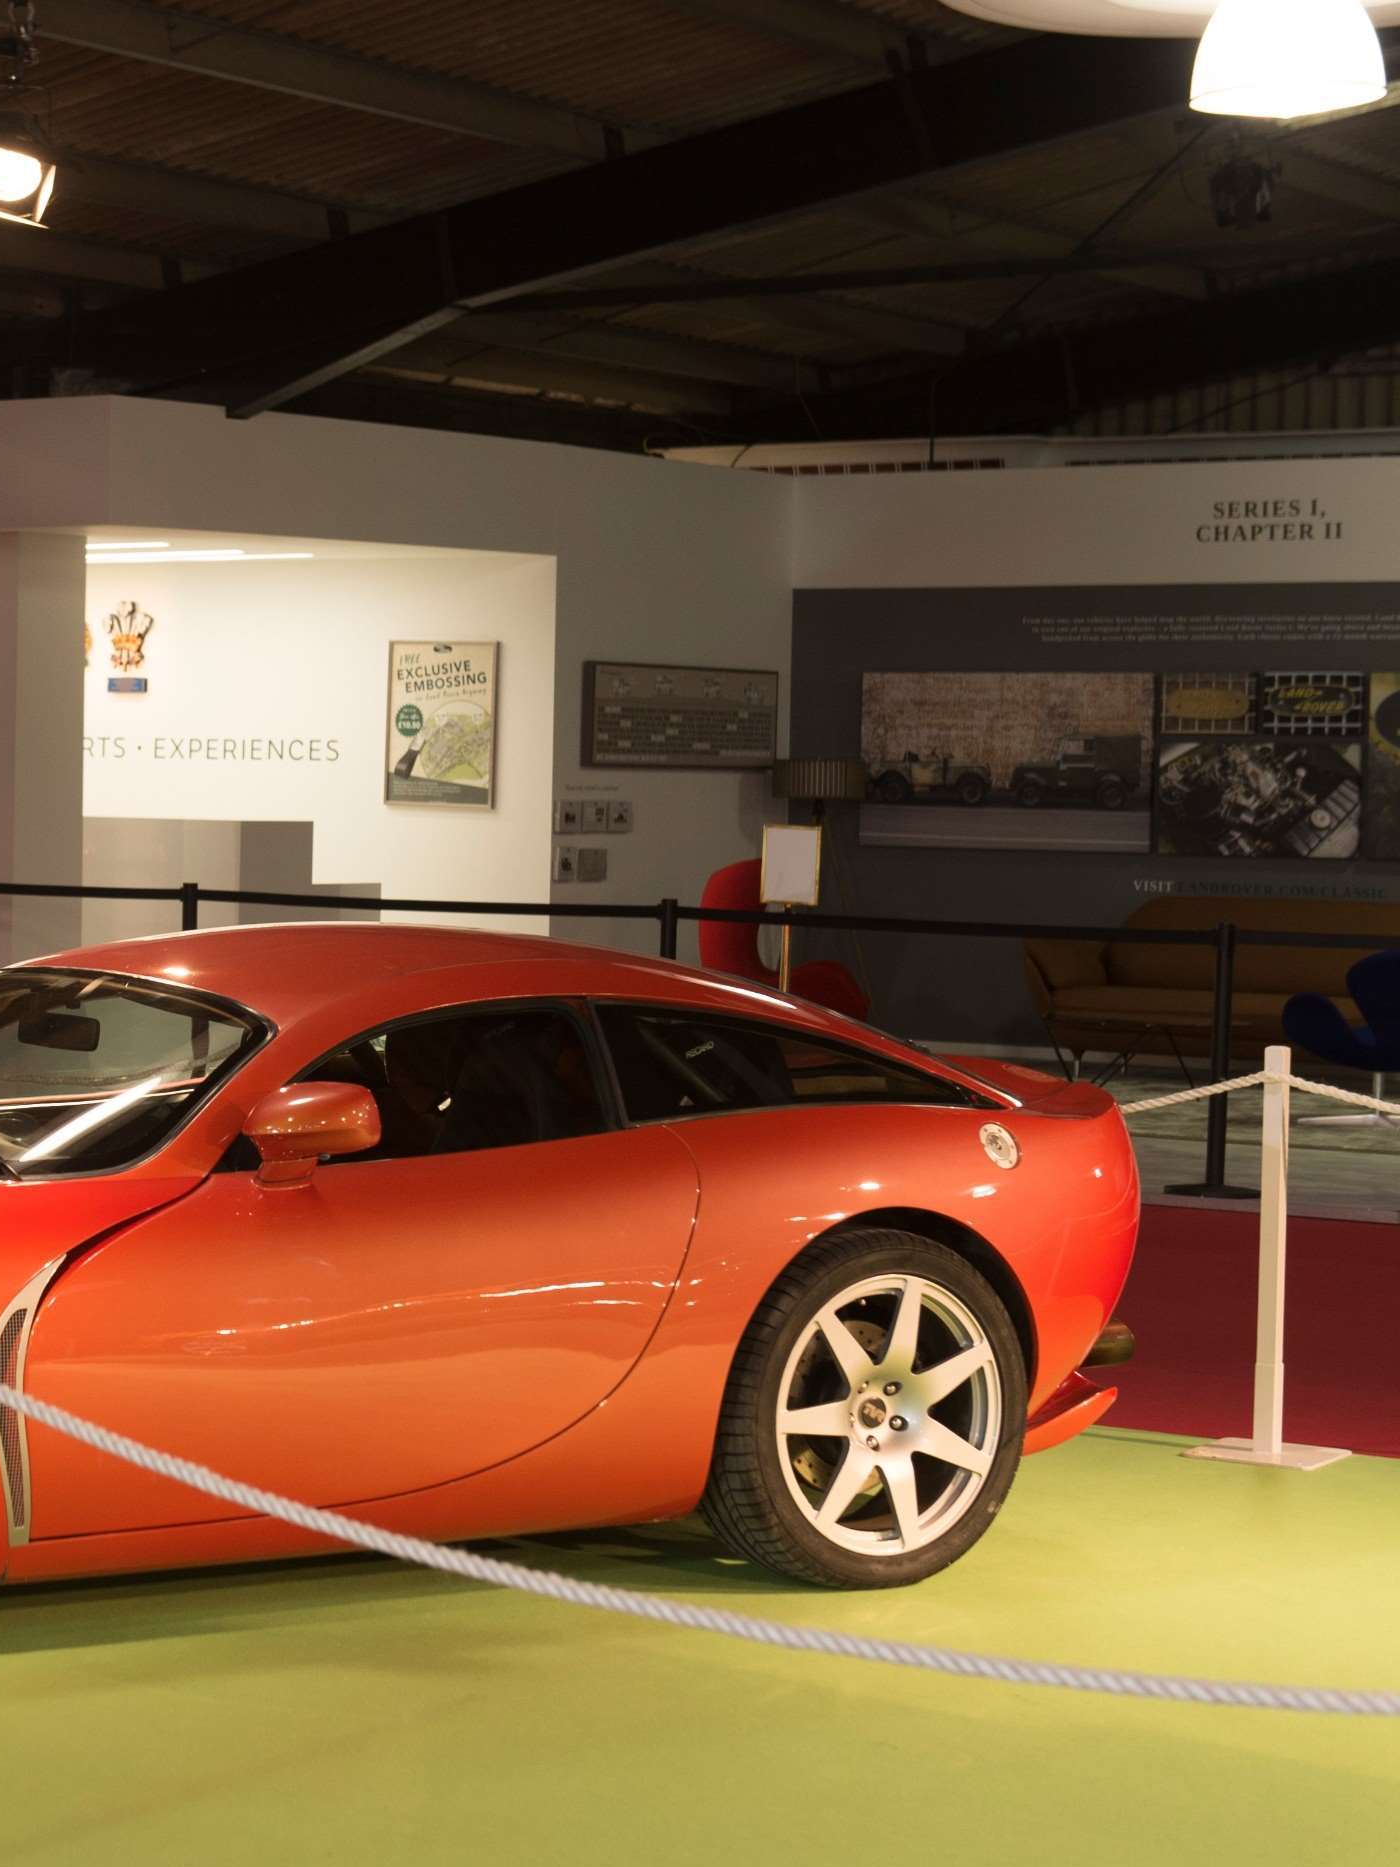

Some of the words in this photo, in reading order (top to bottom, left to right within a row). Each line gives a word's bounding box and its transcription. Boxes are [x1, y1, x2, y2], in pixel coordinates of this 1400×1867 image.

[1213, 499, 1301, 519] SERIES
[1311, 498, 1326, 519] I,
[1196, 523, 1316, 542] CHAPTER
[1324, 522, 1343, 540] II
[397, 660, 472, 680] EXCLUSIVE
[405, 672, 487, 693] EMBOSSING
[83, 737, 126, 758] RTS
[154, 738, 340, 762] EXPERIENCES
[1133, 879, 1173, 893] VISIT
